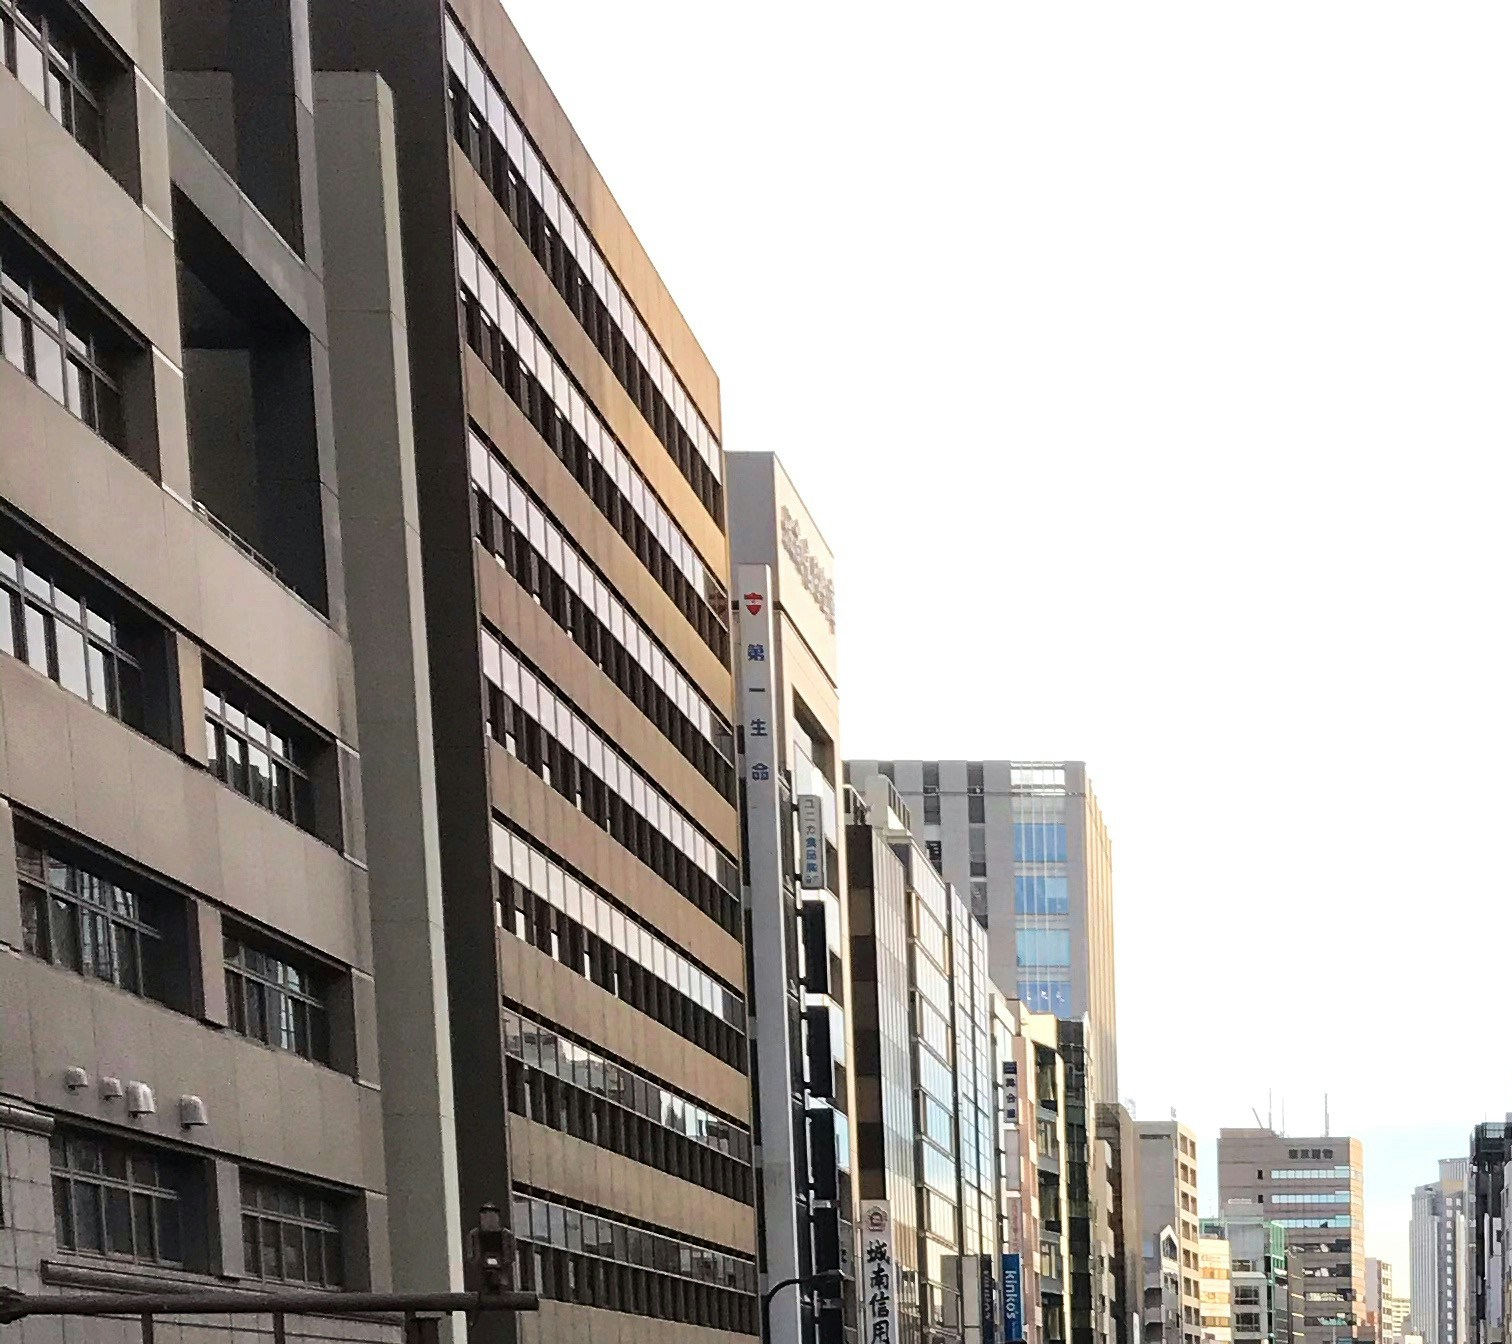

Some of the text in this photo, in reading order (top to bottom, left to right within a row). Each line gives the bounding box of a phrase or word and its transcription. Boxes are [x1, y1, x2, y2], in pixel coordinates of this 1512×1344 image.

[747, 644, 769, 781] 第一生命
[1005, 1270, 1018, 1320] kinko's
